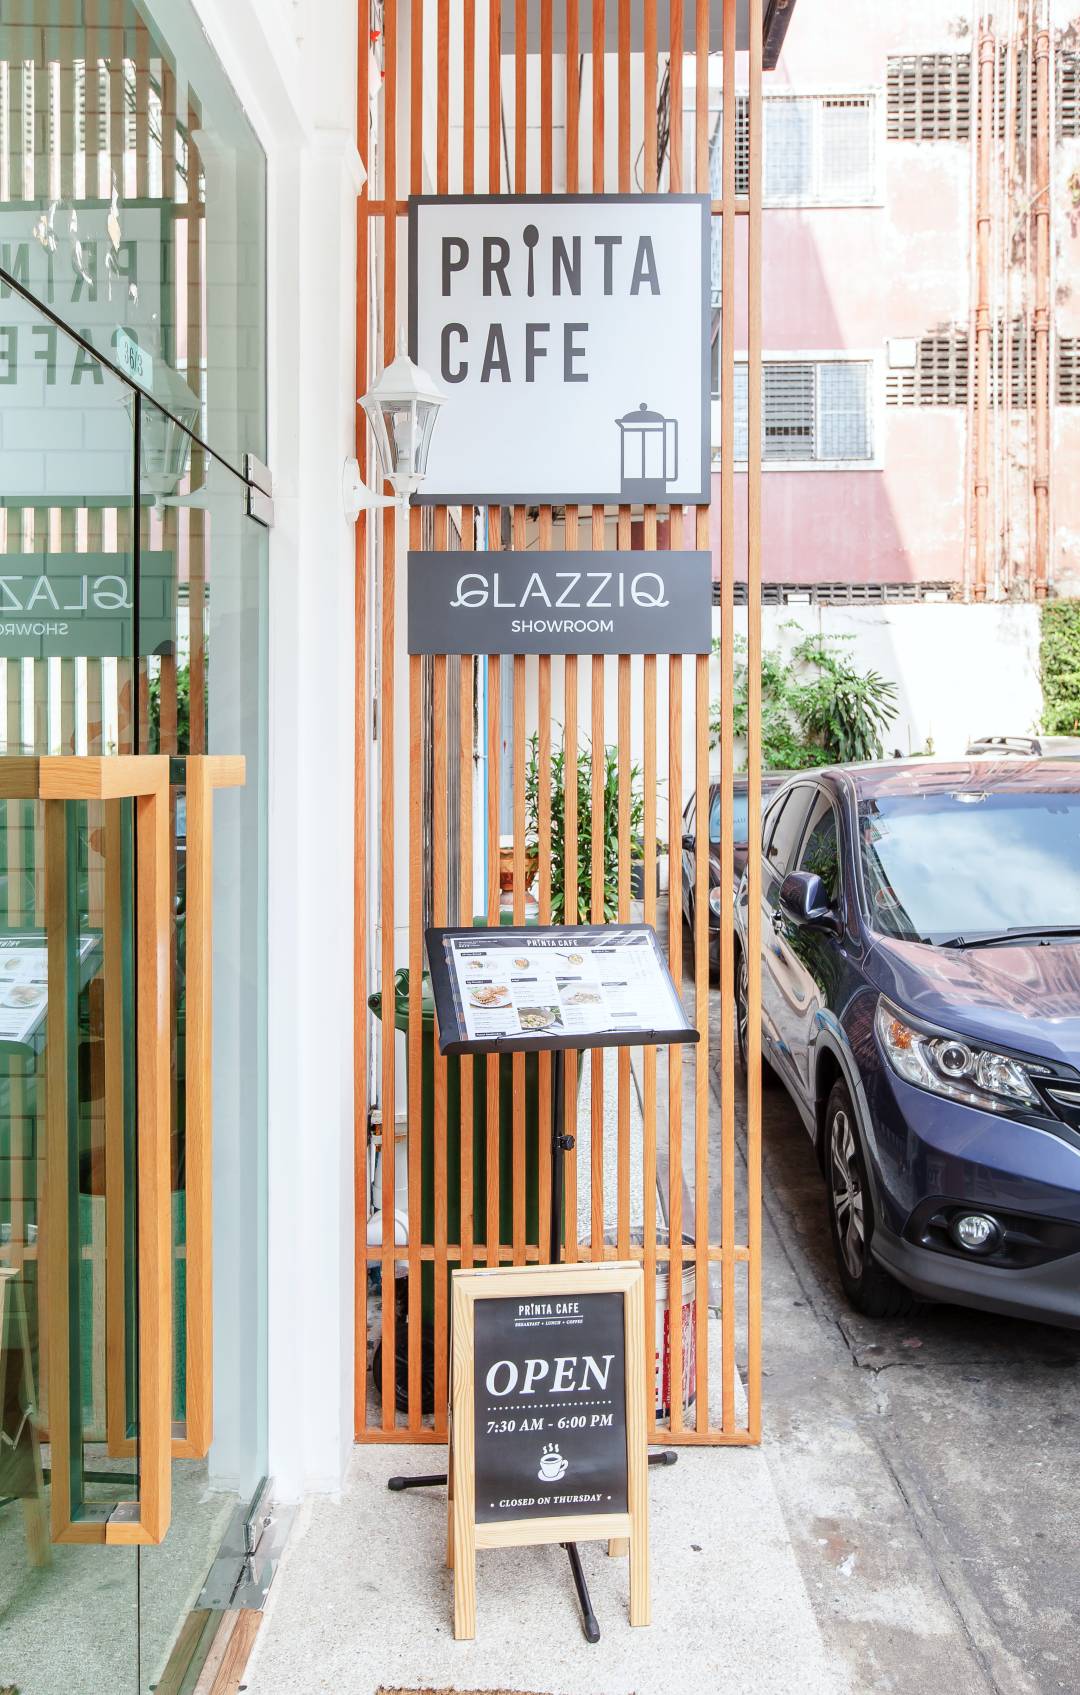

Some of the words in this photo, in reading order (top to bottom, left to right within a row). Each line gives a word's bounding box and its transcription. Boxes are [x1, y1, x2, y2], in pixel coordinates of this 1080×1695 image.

[441, 224, 661, 297] PRINTA
[440, 322, 590, 384] CAFE
[449, 572, 670, 608] GLAZZIQ
[511, 620, 614, 633] SHOWROOM
[526, 938, 556, 948] PRINTA
[557, 938, 579, 947] CAFE
[518, 1303, 552, 1316] PRINTA
[556, 1302, 579, 1314] CAFE
[486, 1354, 615, 1396] OPEN
[487, 1420, 516, 1434] 7:30
[519, 1418, 544, 1431] AM
[557, 1416, 587, 1429] 6:00
[590, 1413, 614, 1427] PM
[499, 1498, 535, 1507] CLOSED
[537, 1497, 551, 1505] ON
[553, 1494, 602, 1504] THURSDAY
